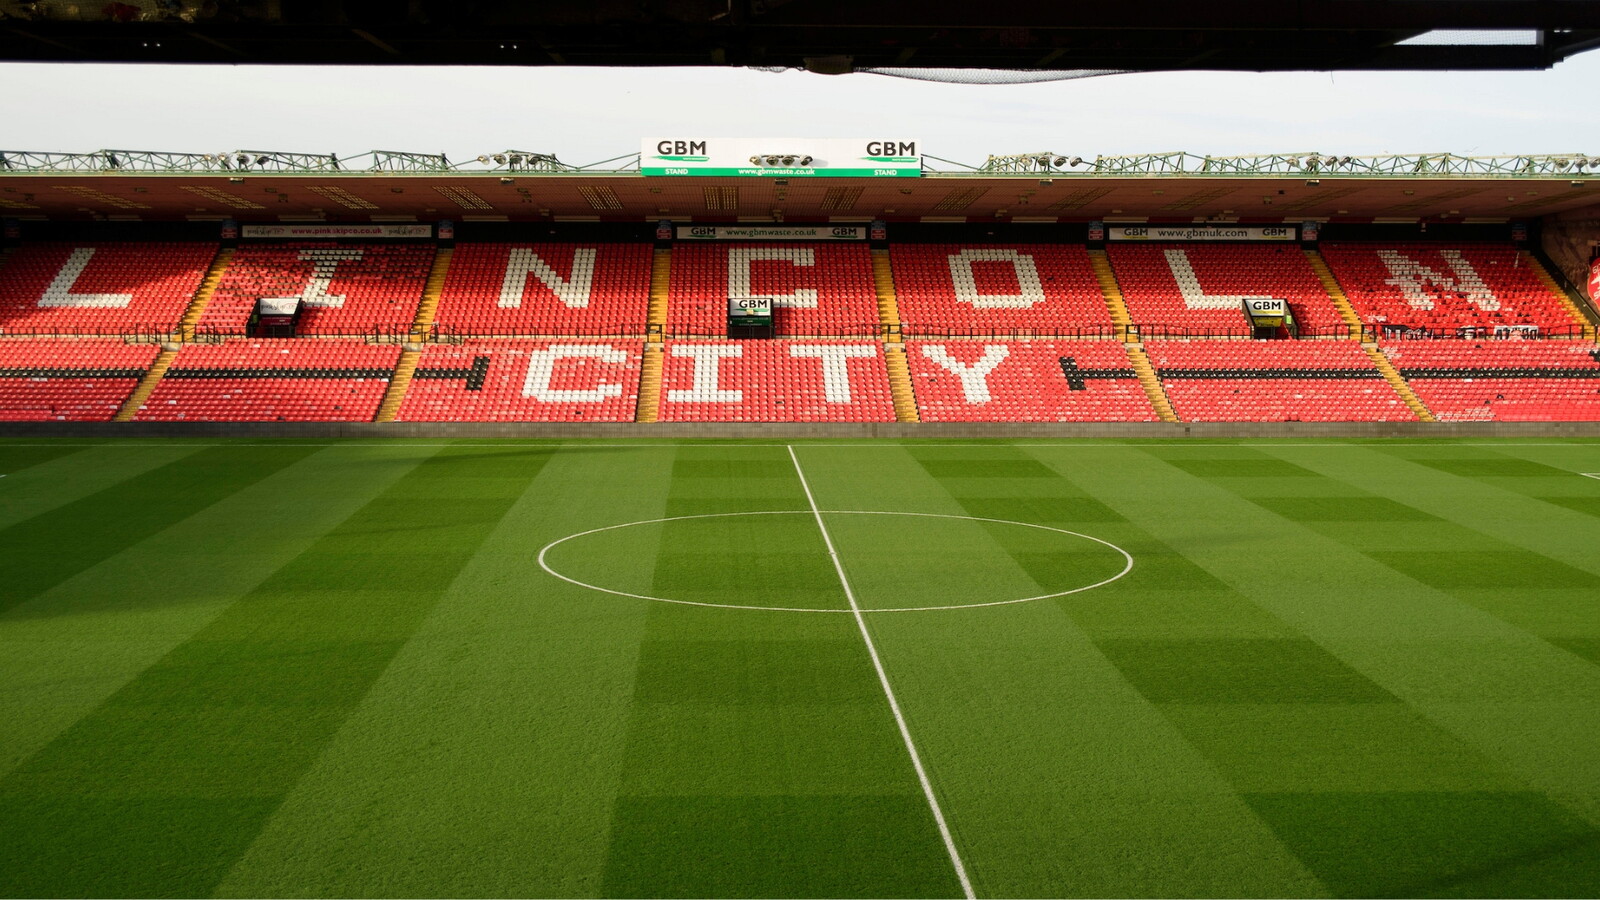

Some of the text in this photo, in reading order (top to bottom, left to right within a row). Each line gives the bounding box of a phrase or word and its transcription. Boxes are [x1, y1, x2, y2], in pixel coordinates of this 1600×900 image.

[657, 140, 707, 156] GBM
[866, 141, 916, 157] GBM
[738, 168, 816, 177] www.gbmwaste.co.uk
[291, 227, 383, 236] www.pinkskipco.co.uk
[691, 227, 716, 236] GBM
[726, 228, 817, 238] www.gbmwaste.co.uk
[832, 227, 857, 236] GBM
[1123, 228, 1149, 237] GBM
[1157, 228, 1248, 239] www.gbmuk.com
[1262, 228, 1287, 237] GBM
[37, 247, 1501, 311] LINCOLN
[739, 299, 768, 309] GBM
[1253, 301, 1281, 310] GBM
[521, 344, 1010, 405] CITY
